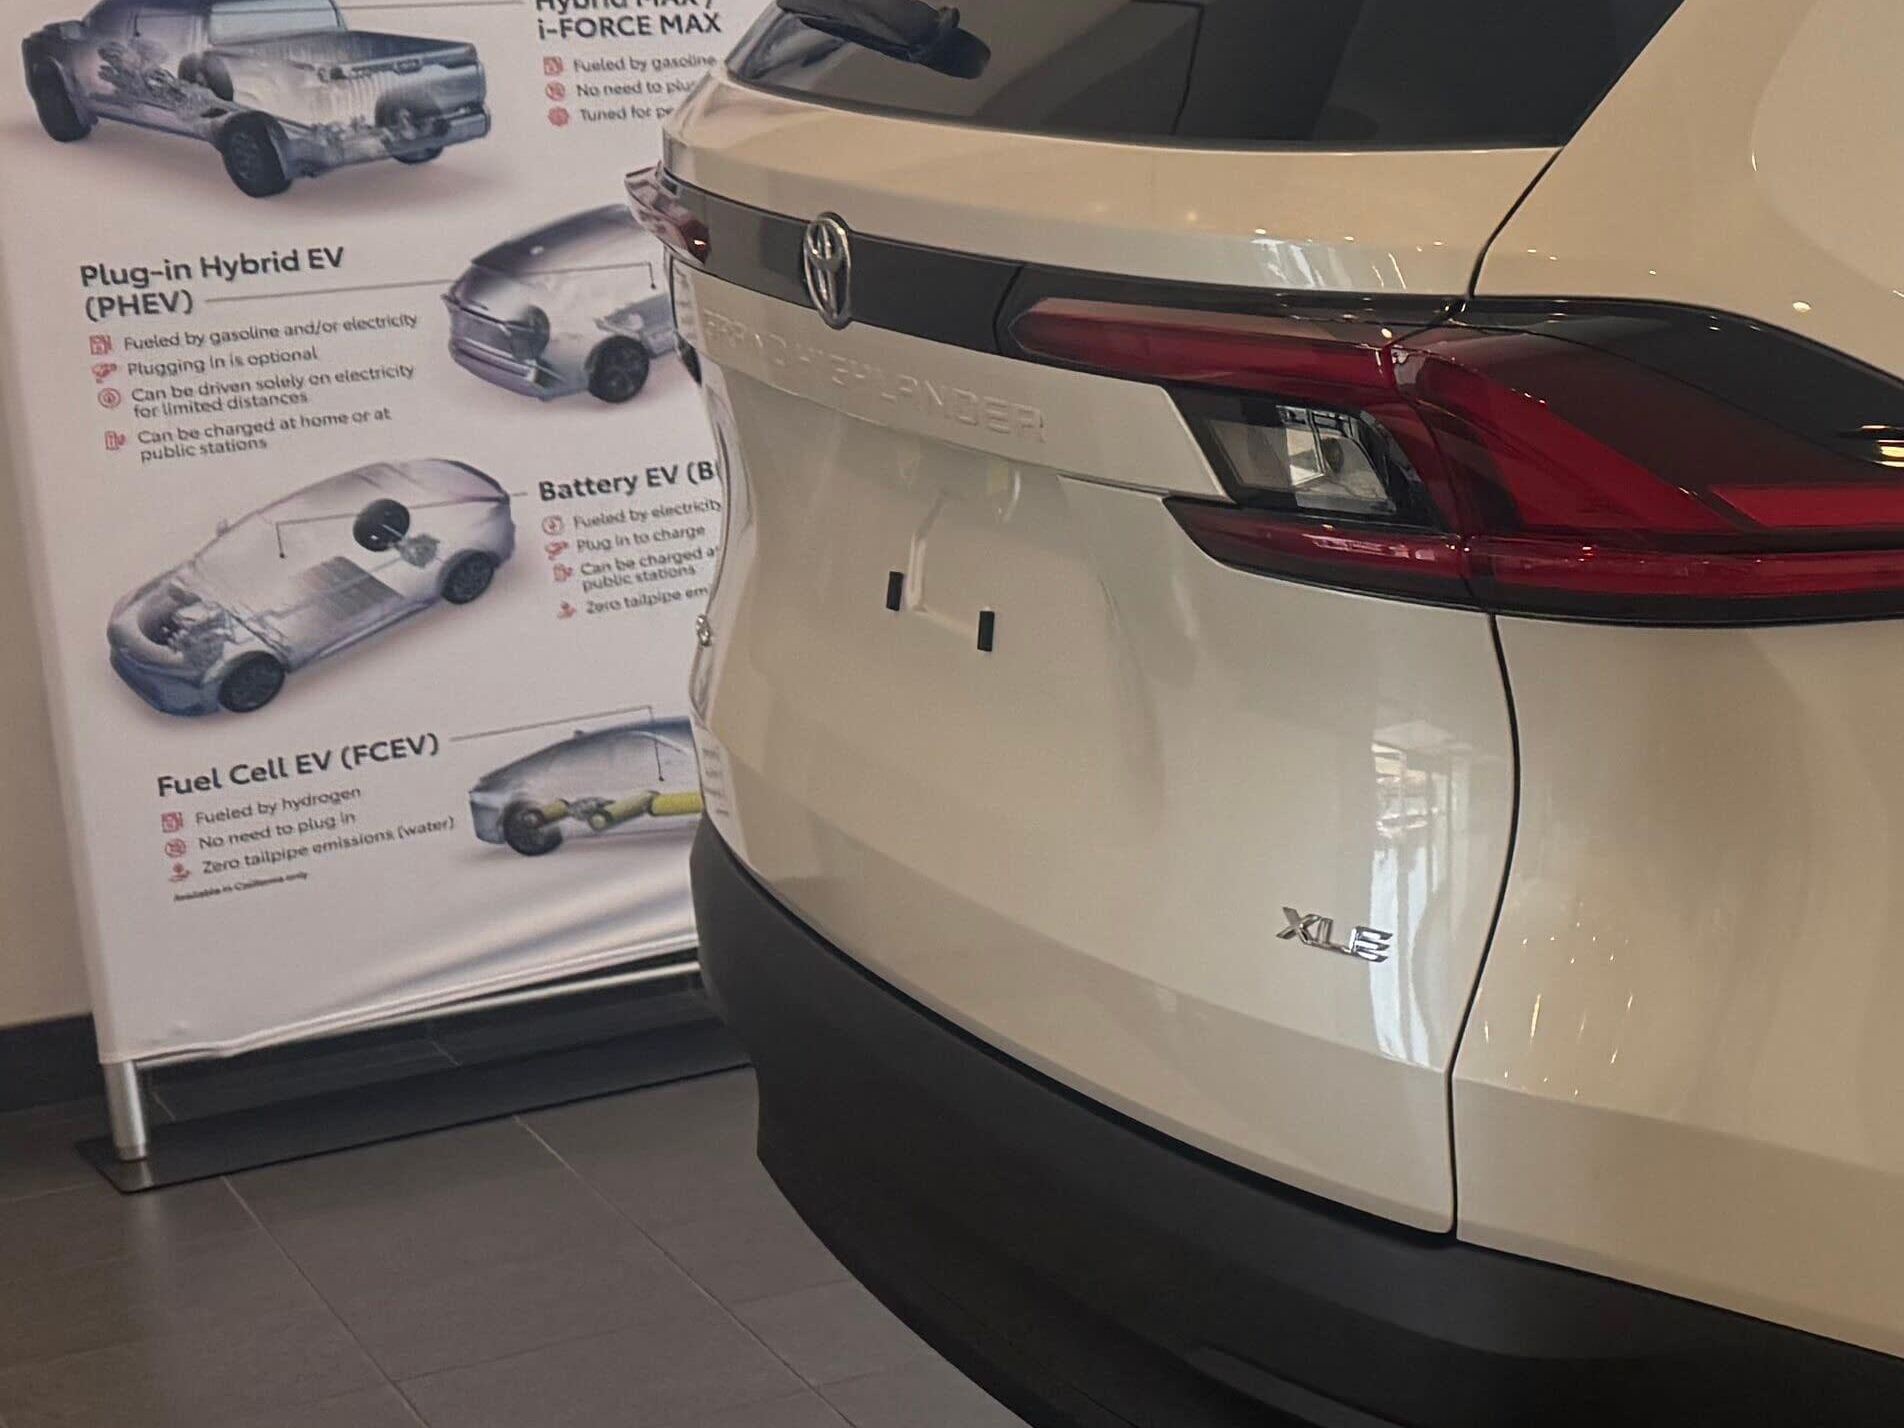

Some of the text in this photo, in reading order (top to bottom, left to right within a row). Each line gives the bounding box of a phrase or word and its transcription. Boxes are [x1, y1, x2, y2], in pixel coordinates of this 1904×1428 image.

[538, 12, 722, 40] i-FORCE MAX
[573, 54, 718, 74] Fueled by gasoline
[576, 80, 696, 98] No need to plu
[579, 107, 627, 122] Tuned
[631, 107, 650, 119] for
[80, 246, 345, 290] Plug-in Hybrid EV
[85, 289, 194, 323] (PHEV)
[123, 312, 418, 352] Fueled by gasoline and/or electricity
[127, 346, 318, 377] Plugging in is optional
[131, 363, 416, 403] Can be driven solely on electricity
[133, 392, 309, 419] for limited distances
[137, 407, 391, 445] Can be charged at home or at
[140, 436, 268, 464] public stations
[538, 460, 715, 502] Battery EV (B
[573, 508, 625, 529] Fueled
[629, 506, 648, 522] by
[577, 523, 706, 554] Plug in to charge
[580, 560, 612, 576] Can
[615, 558, 635, 571] be
[639, 548, 707, 569] charged
[583, 565, 696, 593] public stations
[586, 586, 708, 615] Zero tailpipe em
[157, 732, 439, 797] Fuel Cell EV (FCEV)
[195, 786, 362, 826] Fueled by hydrogen
[199, 811, 356, 850] No need to plug in
[202, 816, 455, 875] Zero tailpipe emissions (water)
[1275, 906, 1394, 963] XLE
